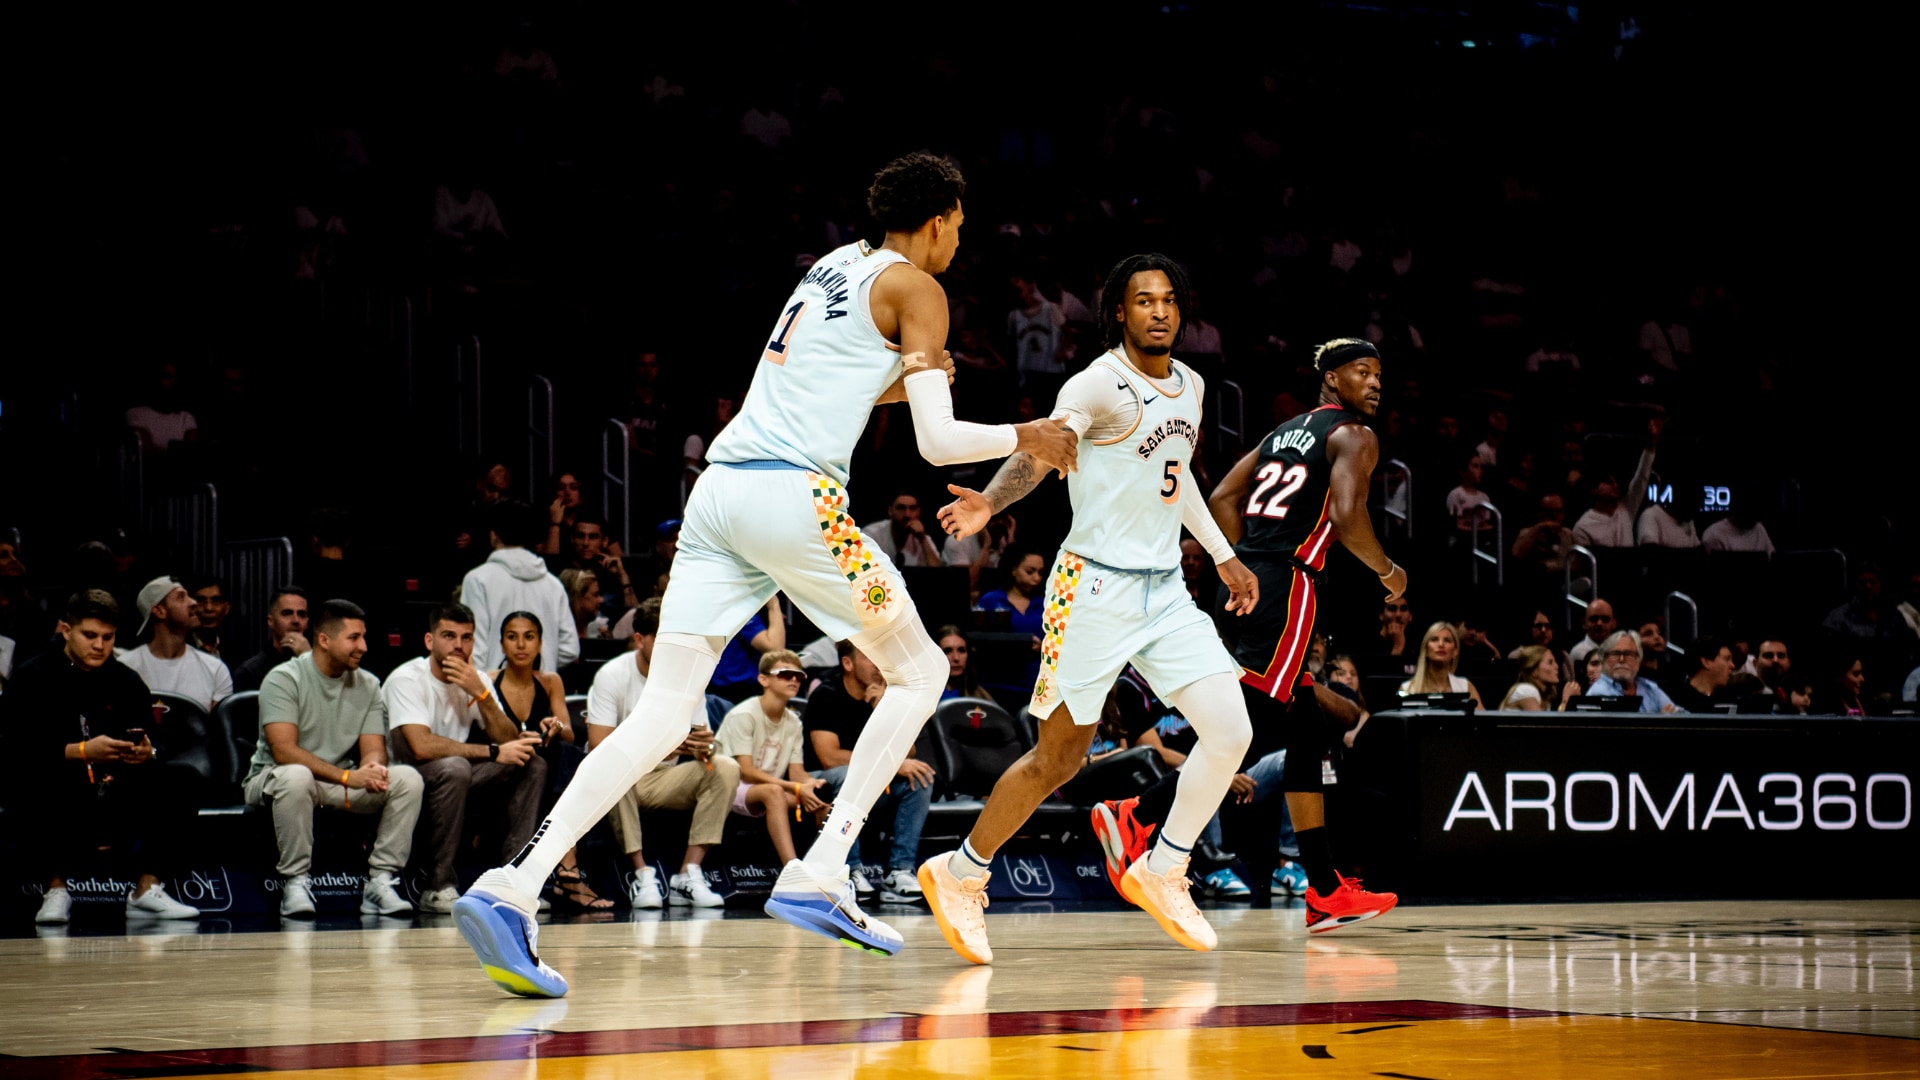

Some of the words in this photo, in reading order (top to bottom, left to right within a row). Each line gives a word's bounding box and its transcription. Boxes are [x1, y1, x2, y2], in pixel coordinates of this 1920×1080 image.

[767, 301, 806, 362] 1
[1138, 426, 1166, 459] SAN
[1272, 429, 1316, 456] BUTLER
[1160, 460, 1181, 501] 5
[1244, 461, 1308, 519] 22
[1442, 771, 1912, 832] AROMA360
[264, 879, 287, 892] ON
[704, 870, 722, 882] NE
[1076, 864, 1100, 877] ONE
